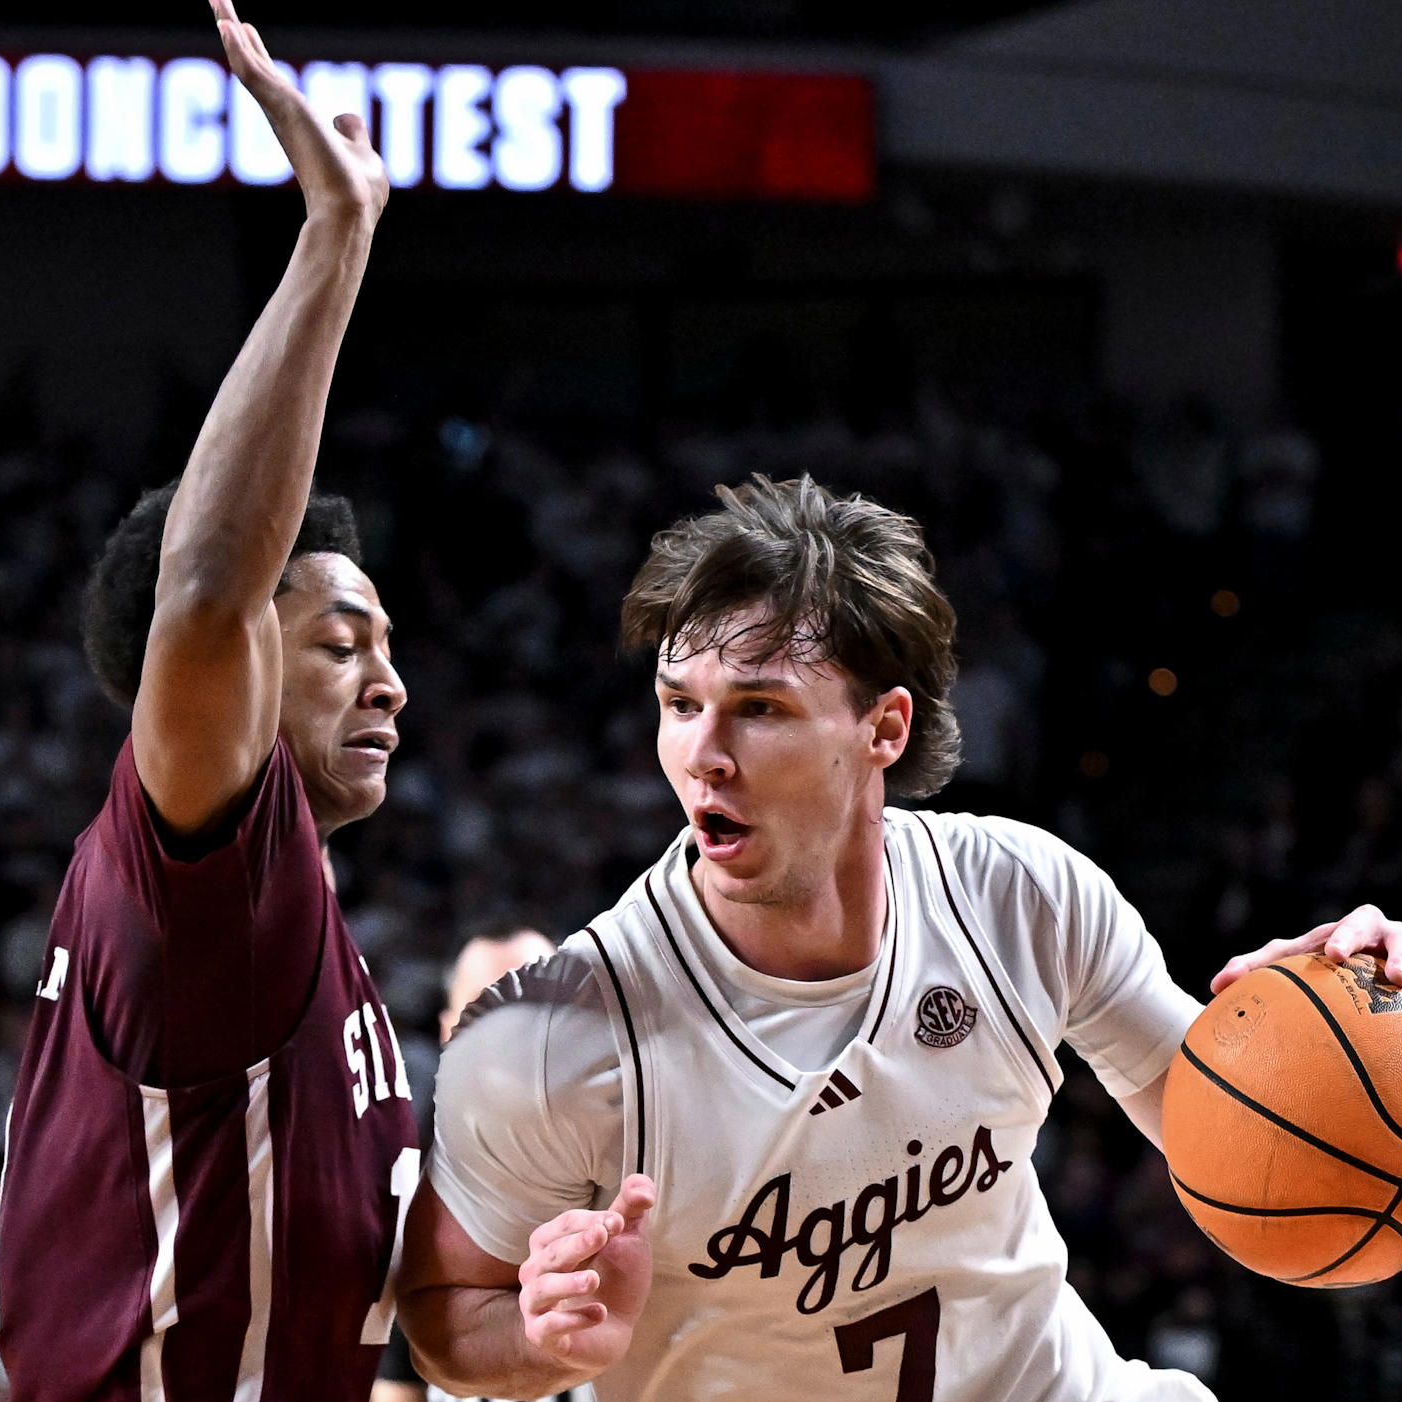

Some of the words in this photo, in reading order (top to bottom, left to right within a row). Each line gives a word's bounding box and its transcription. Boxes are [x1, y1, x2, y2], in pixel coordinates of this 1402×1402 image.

[923, 990, 962, 1032] SEC
[1346, 986, 1363, 1015] BALL
[925, 1011, 975, 1046] GRADUATE
[688, 1125, 1013, 1315] Aggies
